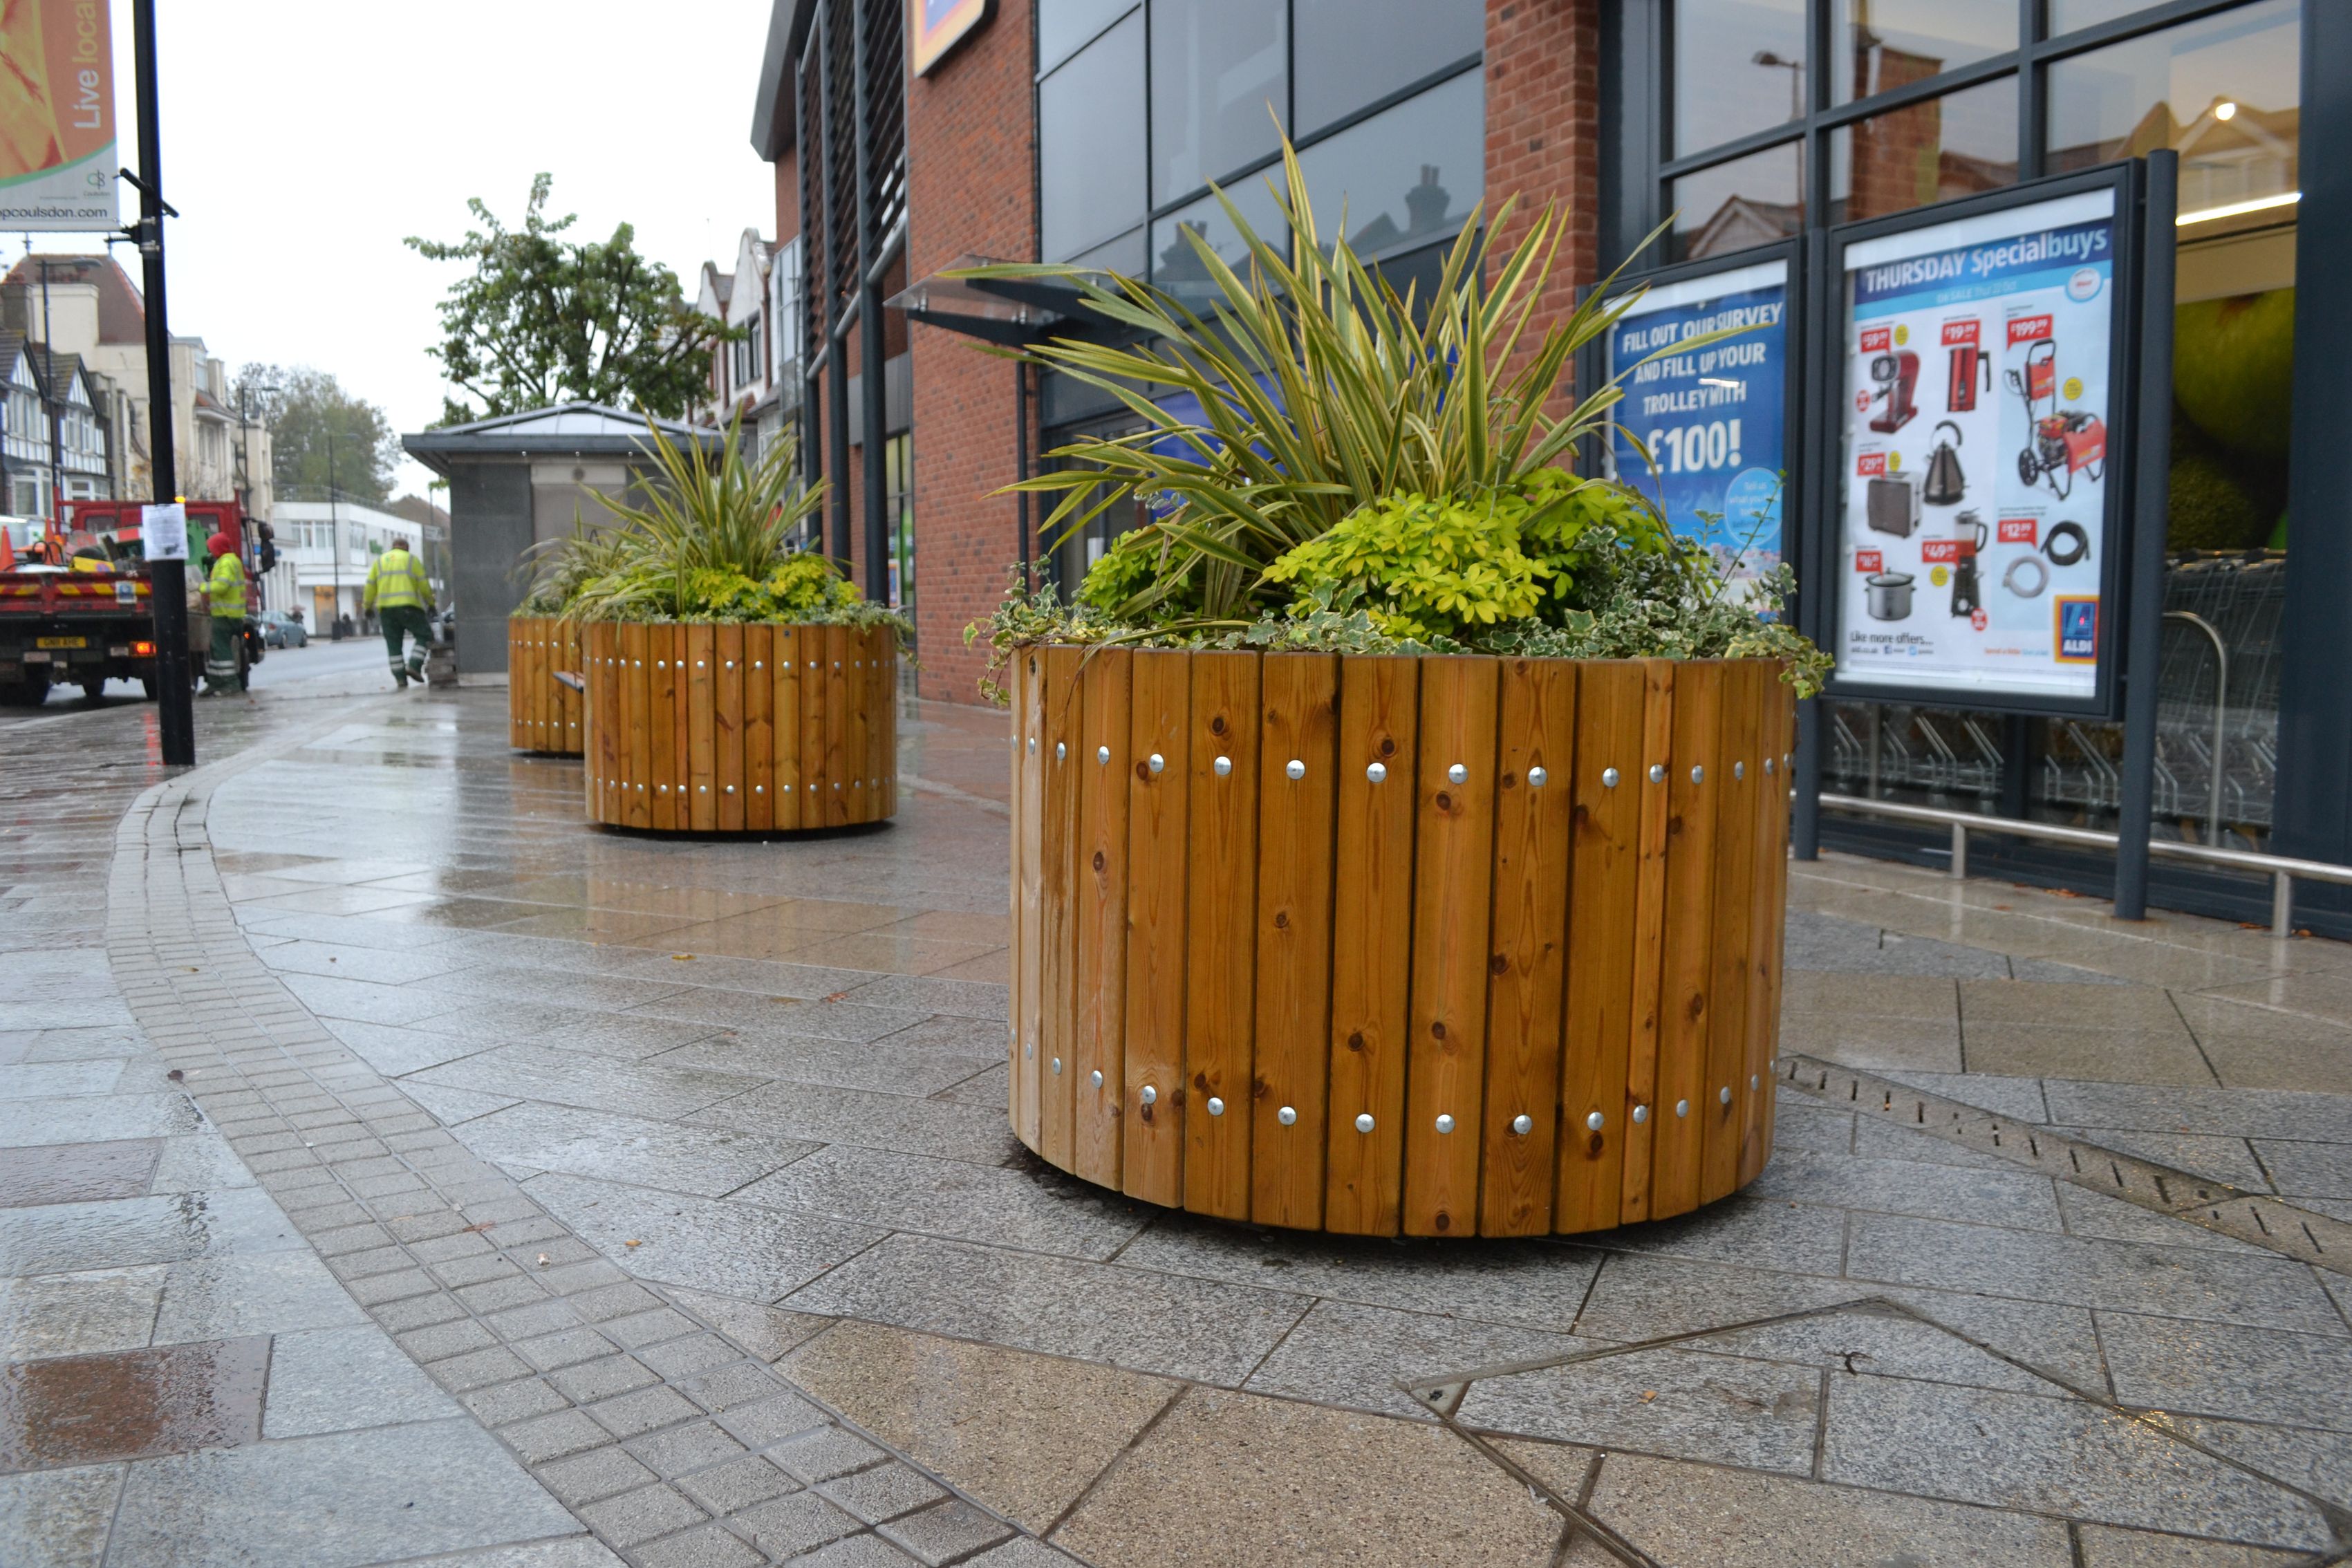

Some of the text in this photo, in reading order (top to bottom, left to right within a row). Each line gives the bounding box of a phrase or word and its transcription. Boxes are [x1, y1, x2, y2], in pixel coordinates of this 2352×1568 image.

[73, 70, 101, 129] Live
[1866, 228, 2107, 293] THURSDAY Specialbuys
[1623, 301, 1783, 353] FILL OUT OUR SURVEY
[1634, 342, 1766, 384] AND FILL UP YOUR
[1643, 381, 1746, 416] TROLLEY WITH
[1646, 418, 1742, 475] £100!
[1851, 631, 1934, 646] Like more offers...
[2063, 640, 2093, 653] ALDI
